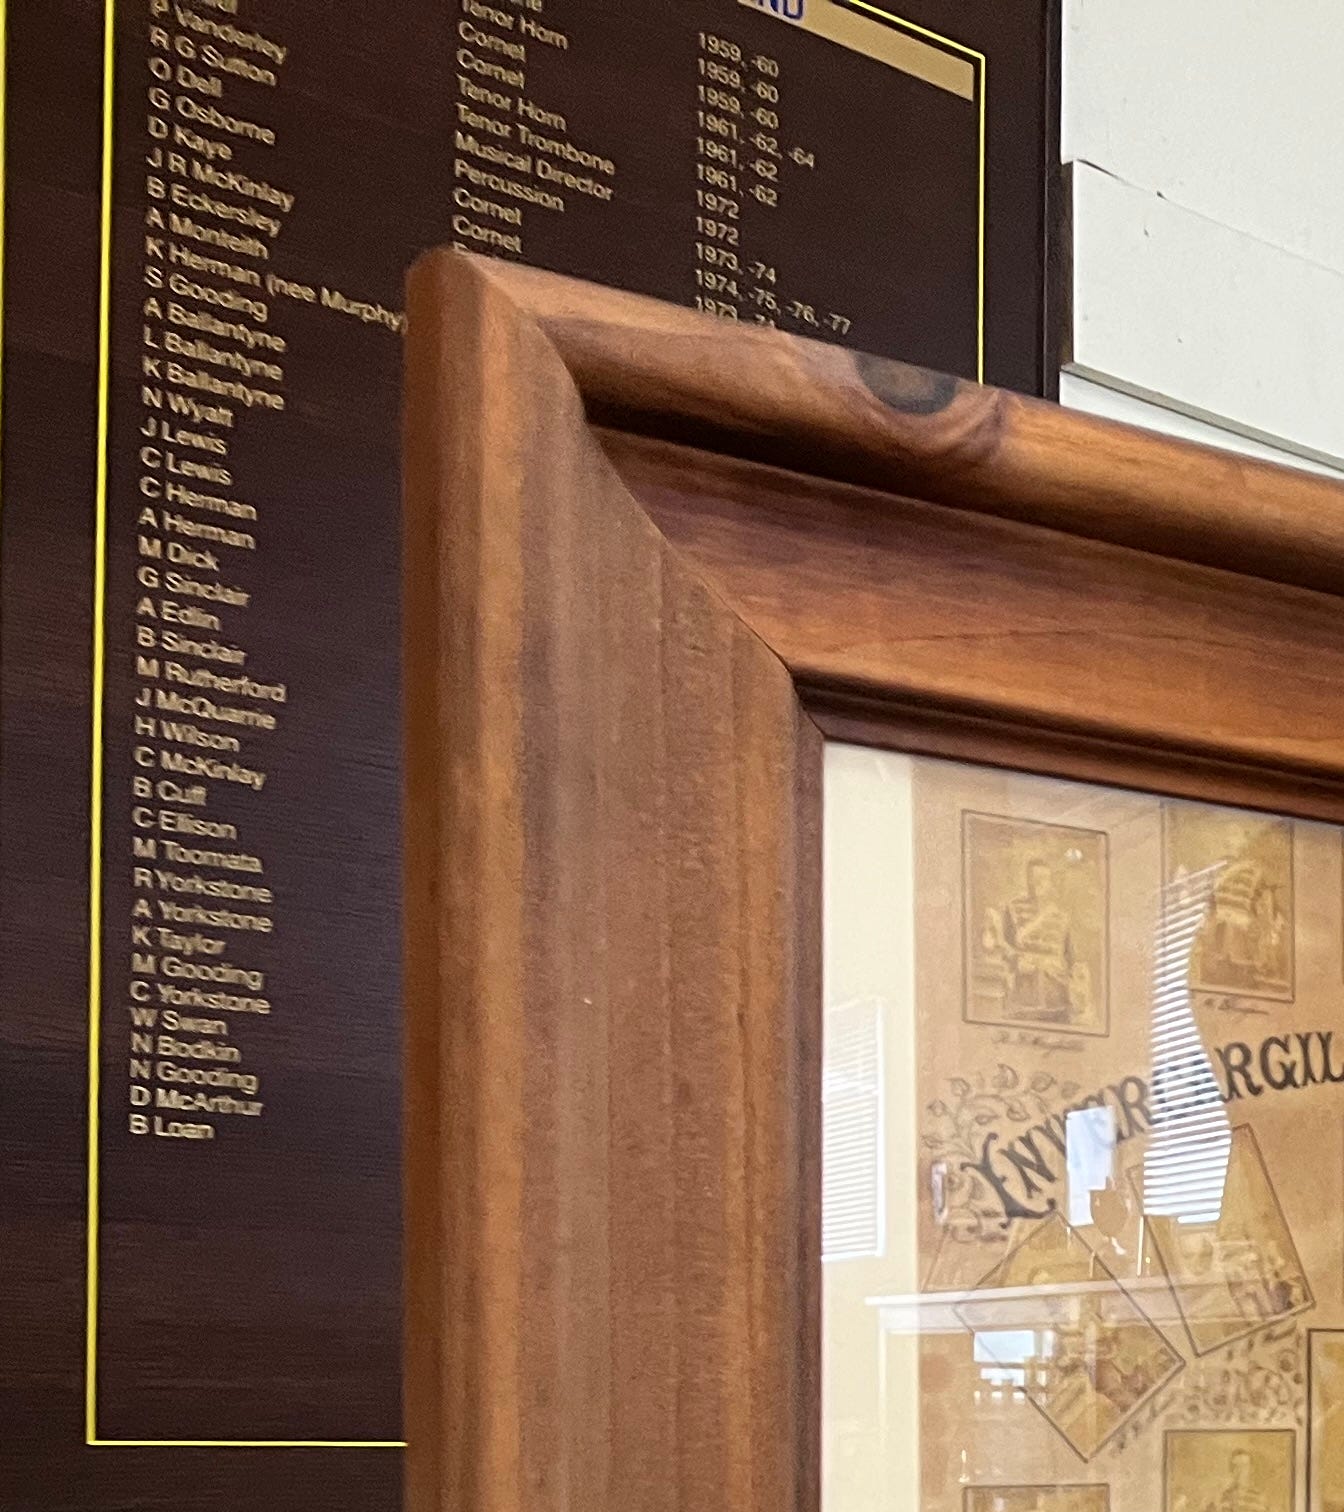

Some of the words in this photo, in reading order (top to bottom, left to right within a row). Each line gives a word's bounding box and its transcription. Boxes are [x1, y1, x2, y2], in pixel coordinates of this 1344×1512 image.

[458, 21, 526, 62] Cornet
[461, 0, 514, 30] Tenor
[519, 16, 568, 50] Horn
[150, 25, 169, 51] R
[174, 35, 196, 59] G
[201, 44, 278, 86] Sutton
[457, 49, 525, 90] Cornet
[752, 54, 779, 78] -60
[149, 86, 170, 111] G
[176, 64, 222, 98] Dell
[752, 81, 779, 103] -60
[456, 73, 512, 111] Tenor
[517, 97, 567, 133] Horn
[752, 107, 779, 130] -60
[148, 115, 168, 139] D
[455, 102, 512, 138] Tenor
[515, 122, 615, 175] Trombone
[455, 130, 532, 173] Musical
[536, 158, 614, 200] Director
[750, 158, 778, 182] -62
[789, 147, 814, 169] -64
[146, 147, 162, 168] J
[168, 151, 188, 177] R
[192, 158, 295, 213] McKinlay
[147, 176, 165, 198] B
[454, 159, 565, 212] Percussion
[750, 184, 777, 207] -62
[453, 188, 522, 226] Cornet
[696, 189, 740, 220] 1972
[146, 207, 165, 230] A
[169, 213, 268, 260] Monteith
[452, 215, 522, 254] Cornet
[696, 216, 739, 246] 1972
[145, 236, 164, 260] K
[169, 242, 261, 287] Herman
[748, 262, 776, 285] -74
[145, 265, 162, 288] S
[169, 272, 268, 322] Gooding
[143, 297, 162, 320] A
[167, 301, 287, 353] Ballantyne
[824, 311, 851, 335] -77
[143, 326, 160, 348] L
[164, 331, 283, 382] Ballantyne
[142, 356, 162, 379] K
[166, 361, 285, 411] Ballantyne
[142, 386, 161, 409] N
[166, 390, 233, 427] Wyatt
[140, 416, 157, 437] J
[162, 421, 228, 455] Lewis
[140, 447, 161, 468] C
[166, 452, 232, 485] Lewis
[140, 476, 161, 498] C
[166, 481, 257, 521] Herman
[138, 507, 158, 528] A
[163, 510, 256, 550] Herman
[138, 535, 161, 559] M
[167, 543, 220, 571] Dick
[138, 566, 159, 588] G
[165, 572, 250, 607] Sinclair
[136, 597, 158, 619] A
[136, 625, 157, 648] B
[161, 630, 247, 665] Sinclair
[137, 656, 159, 678] M
[165, 661, 287, 702] Rutherford
[136, 688, 151, 707] J
[135, 715, 156, 738] H
[160, 720, 240, 752] Wilson
[135, 746, 155, 767] C
[161, 750, 266, 791] McKinlay
[133, 777, 153, 798] B
[157, 780, 207, 806] Cuff
[132, 807, 155, 828] C
[159, 809, 237, 840] Ellison
[133, 836, 157, 859] M
[134, 867, 153, 889] R
[154, 869, 273, 903] Yorkstone
[133, 899, 152, 919] A
[157, 901, 273, 932] Yorkstone
[132, 925, 152, 947] K
[157, 927, 226, 956] Taylor
[132, 953, 156, 974] M
[161, 956, 264, 990] Gooding
[130, 981, 151, 1001] C
[157, 984, 271, 1014] Yorkstone
[130, 1007, 158, 1028] W
[161, 1010, 228, 1035] Swan
[131, 1033, 153, 1054] N
[130, 1059, 150, 1080] N
[156, 1062, 260, 1094] Gooding
[130, 1085, 151, 1107] D
[156, 1088, 264, 1117] McArthur
[128, 1114, 149, 1135] B
[154, 1116, 215, 1139] Loan
